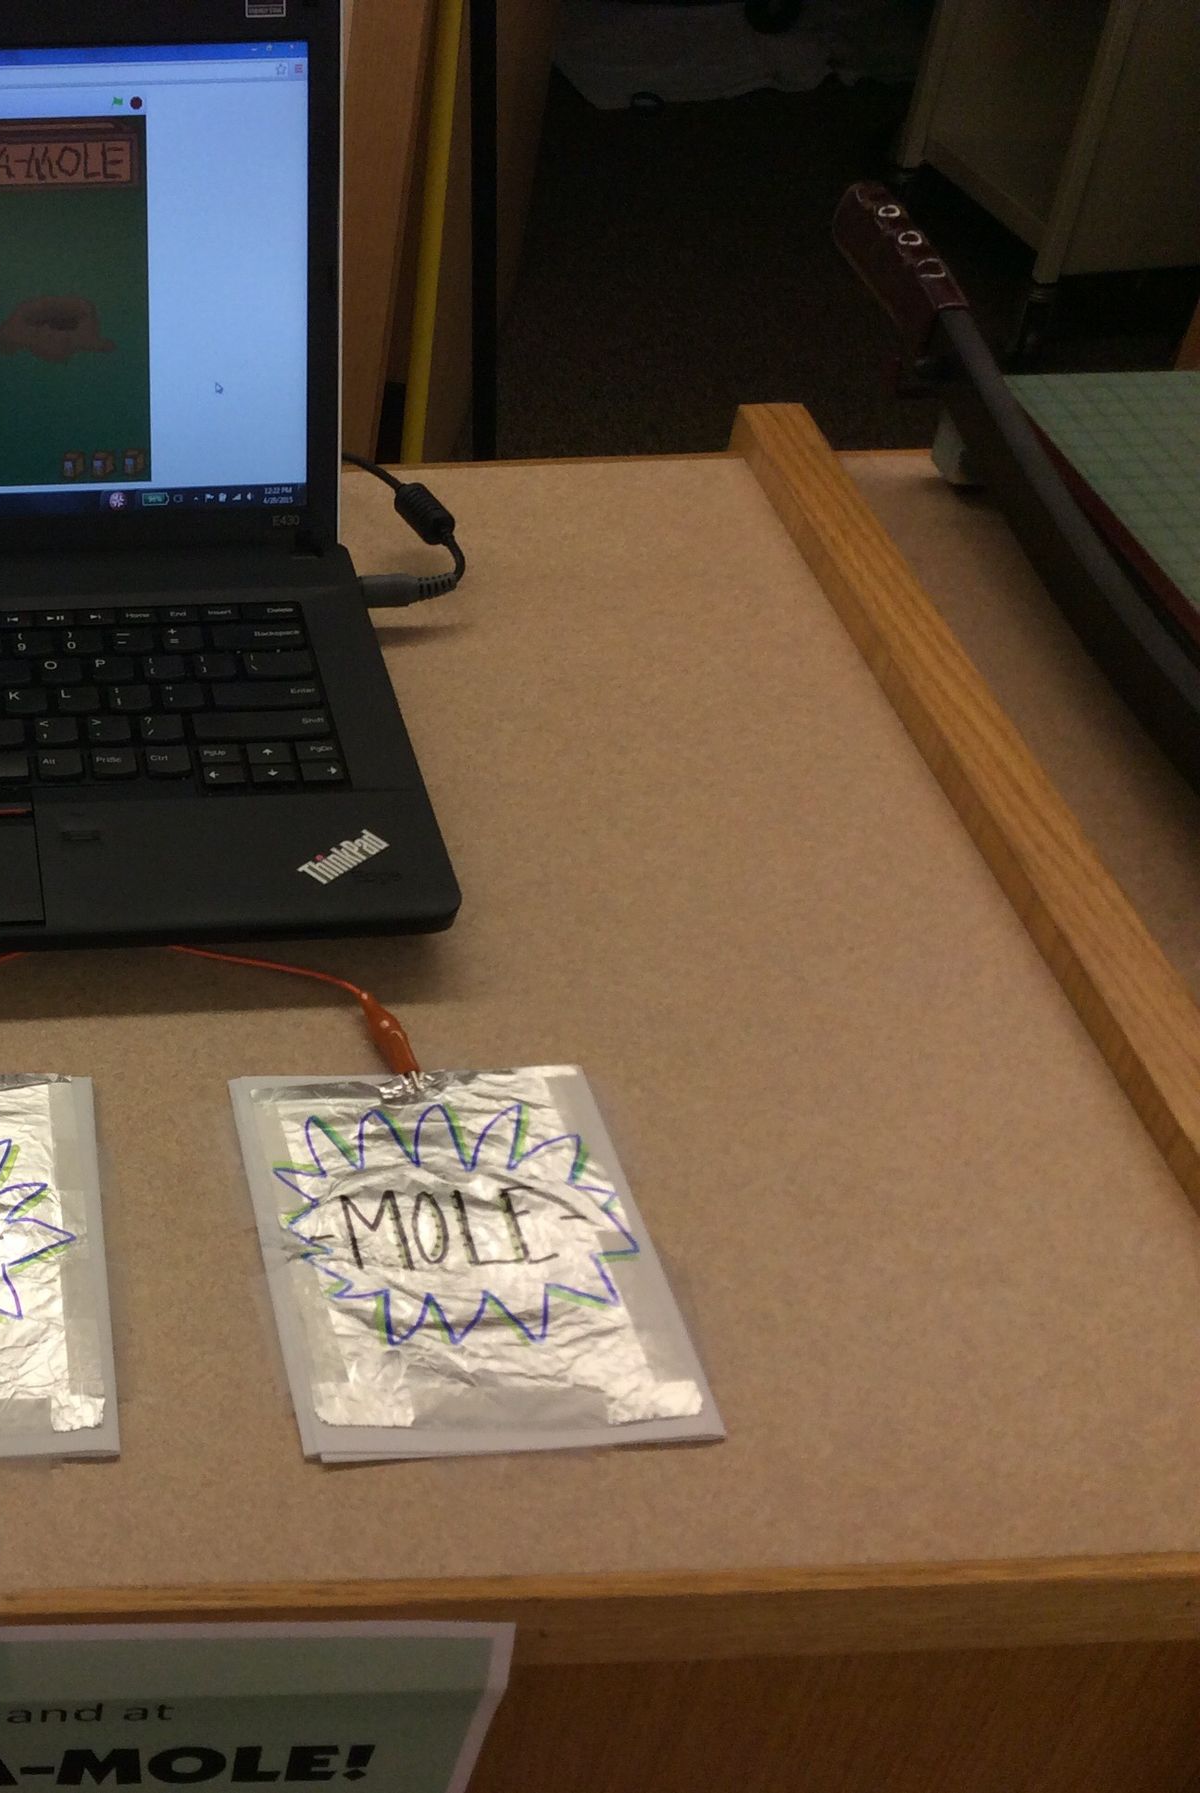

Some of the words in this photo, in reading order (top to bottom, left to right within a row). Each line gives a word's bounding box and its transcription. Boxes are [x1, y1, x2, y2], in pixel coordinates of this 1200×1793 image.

[169, 610, 187, 618] End
[43, 661, 58, 671] O
[94, 659, 107, 668] P
[8, 690, 21, 701] K
[60, 688, 72, 699] L
[296, 828, 390, 885] ThinkPad
[123, 1702, 175, 1722] at
